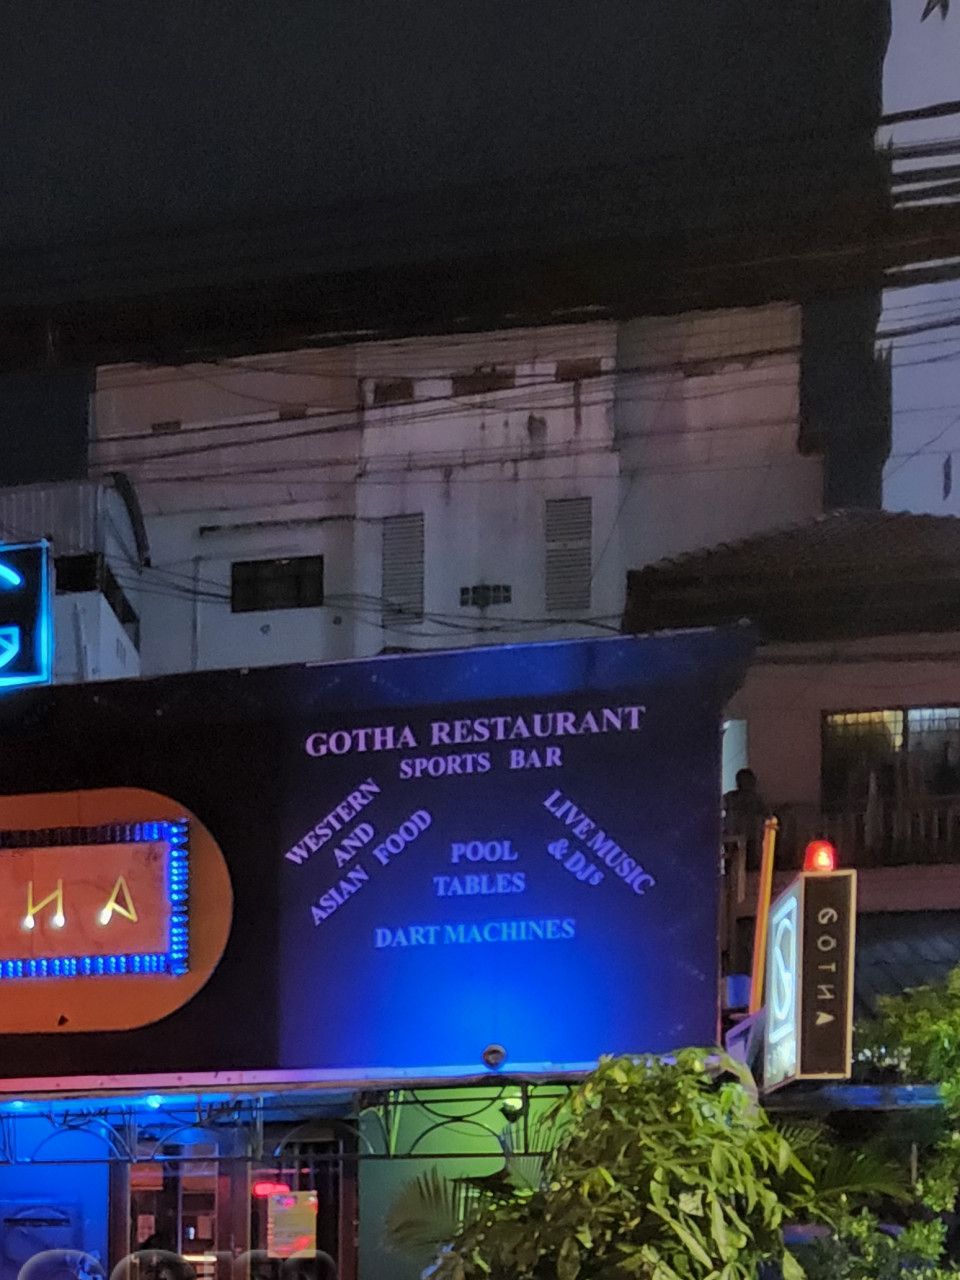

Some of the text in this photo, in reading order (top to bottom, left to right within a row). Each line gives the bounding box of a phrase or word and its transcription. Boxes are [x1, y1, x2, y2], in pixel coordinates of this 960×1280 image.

[305, 706, 646, 757] GOTHA RESTAURANT
[399, 747, 563, 780] SPORTS BAR
[284, 776, 383, 867] WESTERN
[332, 821, 376, 868] AND
[542, 788, 656, 896] LIVE MUSIC
[310, 809, 433, 927] ASIAN FOOD
[451, 841, 519, 863] POOL
[547, 838, 605, 887] & DJs
[433, 872, 527, 897] TABLES
[374, 919, 576, 949] DART MACHINES
